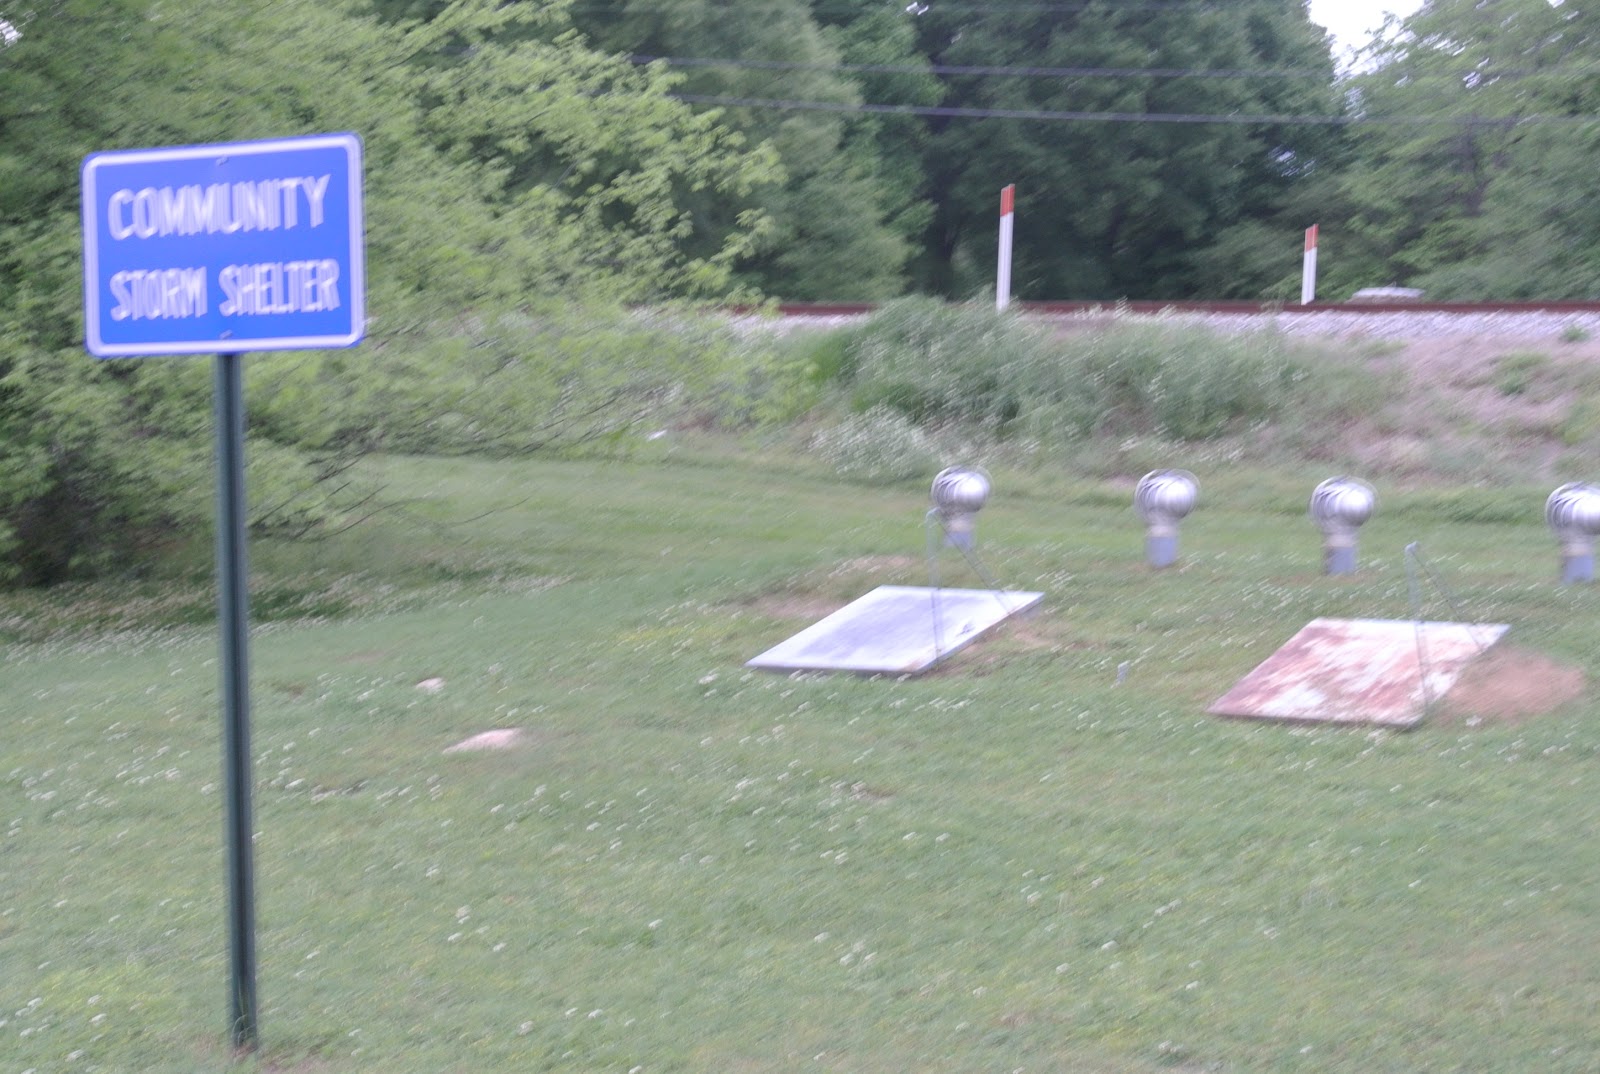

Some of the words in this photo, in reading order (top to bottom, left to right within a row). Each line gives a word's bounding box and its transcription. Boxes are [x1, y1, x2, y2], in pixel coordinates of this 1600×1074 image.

[108, 174, 331, 240] COMMUNITY
[110, 266, 208, 321] STORM
[219, 258, 340, 317] SHELTER
